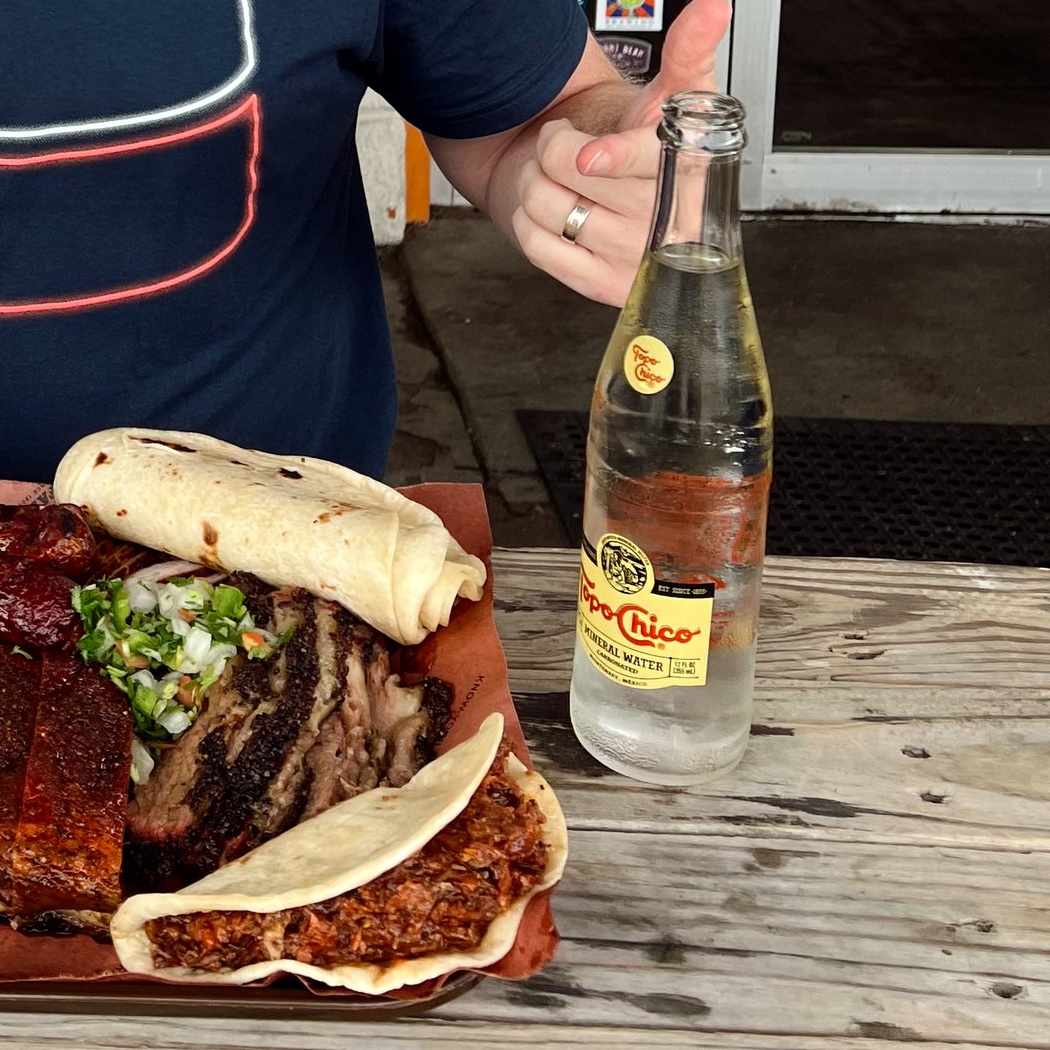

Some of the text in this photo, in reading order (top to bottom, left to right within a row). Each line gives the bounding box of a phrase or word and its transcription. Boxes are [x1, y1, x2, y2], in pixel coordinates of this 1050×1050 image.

[632, 344, 660, 366] Topo
[634, 363, 666, 383] Chico
[616, 602, 702, 648] Chico
[584, 623, 664, 672] MINERAL WATER
[596, 649, 639, 675] CARBONATED
[459, 675, 486, 711] KNOW
